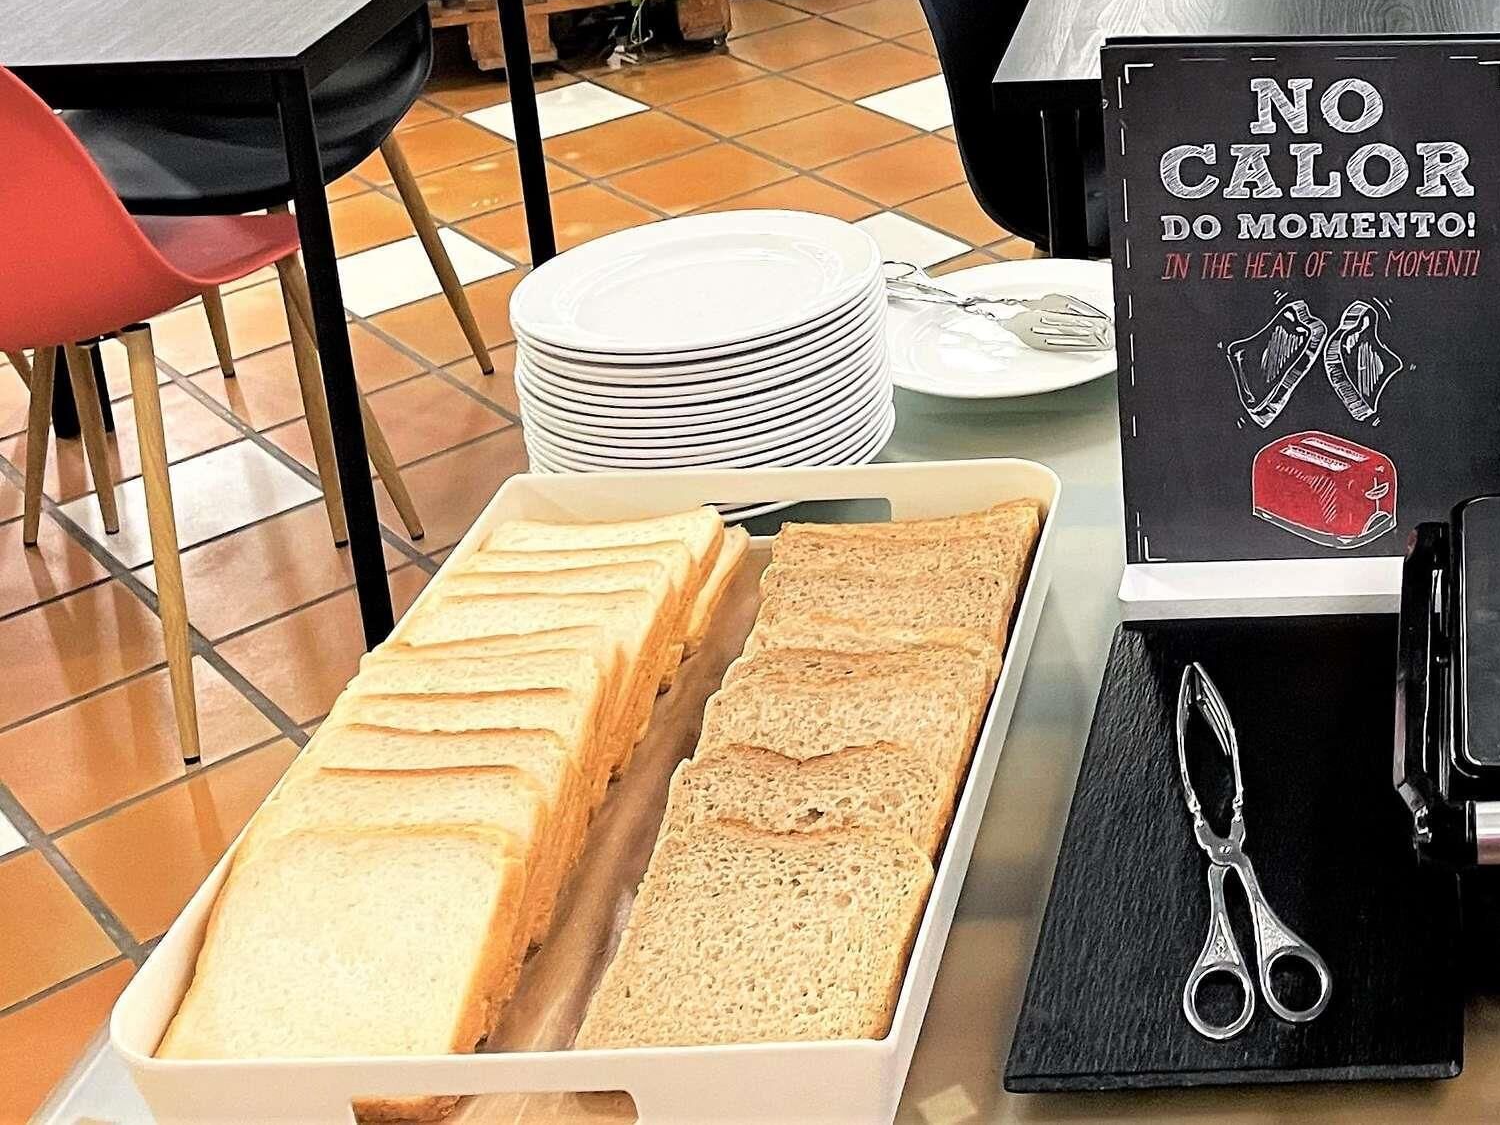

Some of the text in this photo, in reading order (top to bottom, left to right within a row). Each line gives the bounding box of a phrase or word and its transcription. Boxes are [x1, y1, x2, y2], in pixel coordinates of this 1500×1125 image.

[1250, 77, 1384, 134] NO
[1160, 142, 1475, 199] CALOR
[1160, 212, 1476, 241] DO MOMENTO!
[1161, 253, 1191, 280] IN
[1201, 251, 1238, 280] THE
[1244, 251, 1299, 279] HEAT
[1304, 250, 1333, 278] OF
[1340, 250, 1379, 278] THE
